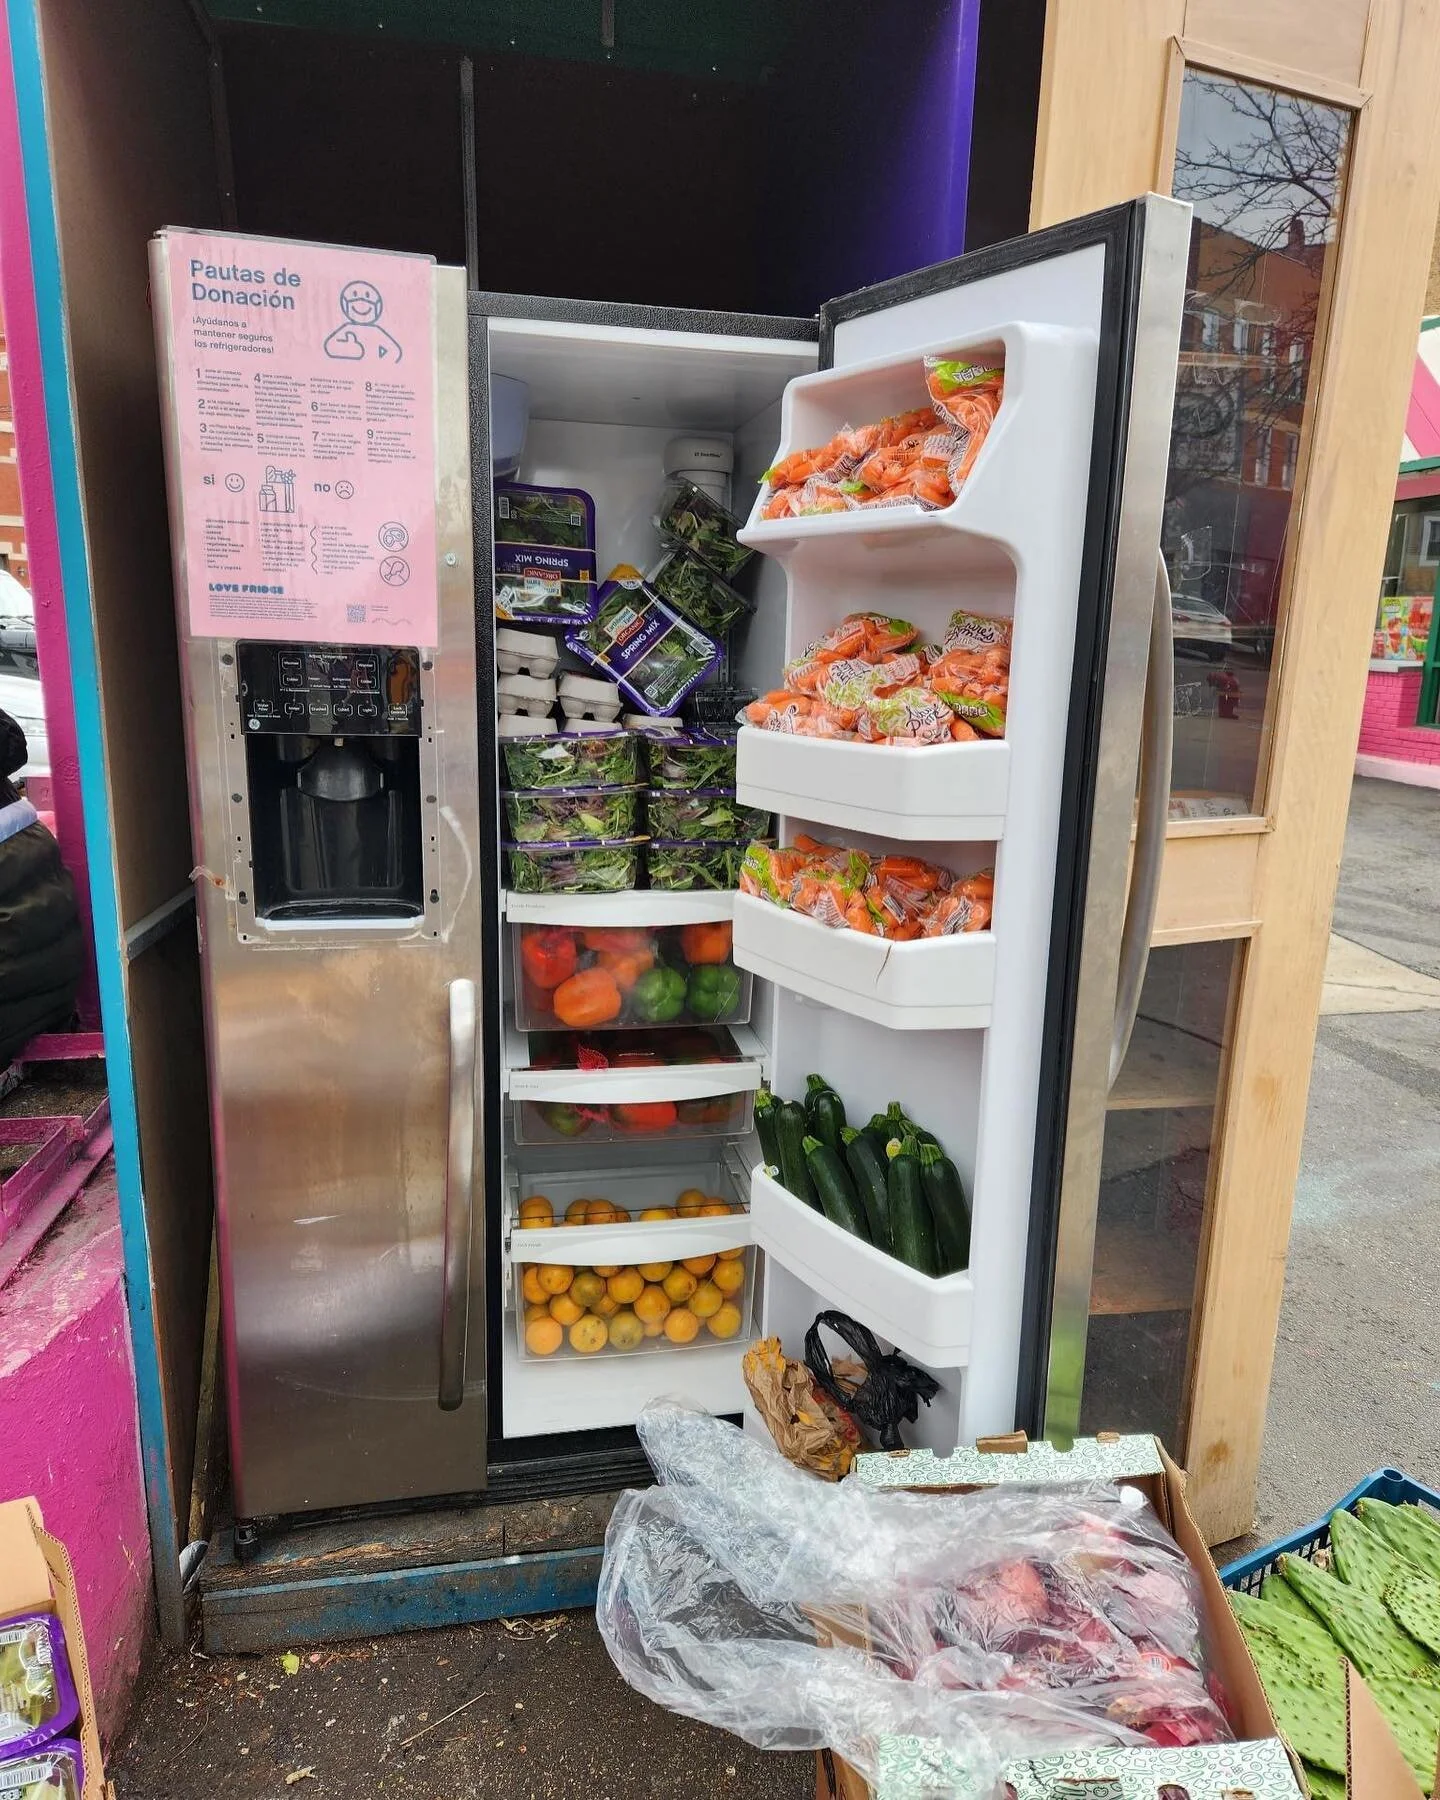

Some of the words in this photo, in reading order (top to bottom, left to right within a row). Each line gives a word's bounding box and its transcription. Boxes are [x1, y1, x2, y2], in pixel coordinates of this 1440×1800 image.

[190, 259, 265, 283] Pautas
[273, 267, 301, 287] de
[191, 282, 295, 310] Donación
[193, 328, 236, 339] mantener
[238, 332, 273, 342] seguros
[194, 340, 207, 348] los
[210, 342, 274, 354] refrigeradores!
[196, 368, 201, 378] 1
[253, 373, 261, 383] 4
[365, 381, 372, 391] 8
[198, 398, 205, 409] 2
[311, 401, 319, 411] 6
[200, 422, 207, 433] 3
[257, 433, 264, 443] 5
[312, 431, 319, 441] 7
[366, 428, 374, 439] 9
[314, 482, 331, 493] no
[514, 554, 532, 563] MIX
[534, 556, 569, 567] SPRING
[526, 570, 558, 579] ORGANIC
[208, 583, 239, 593] LOVE
[241, 584, 284, 594] FRIDGE
[618, 621, 642, 641] ORGANIC
[621, 633, 647, 660] SPRING
[645, 619, 660, 635] MIX
